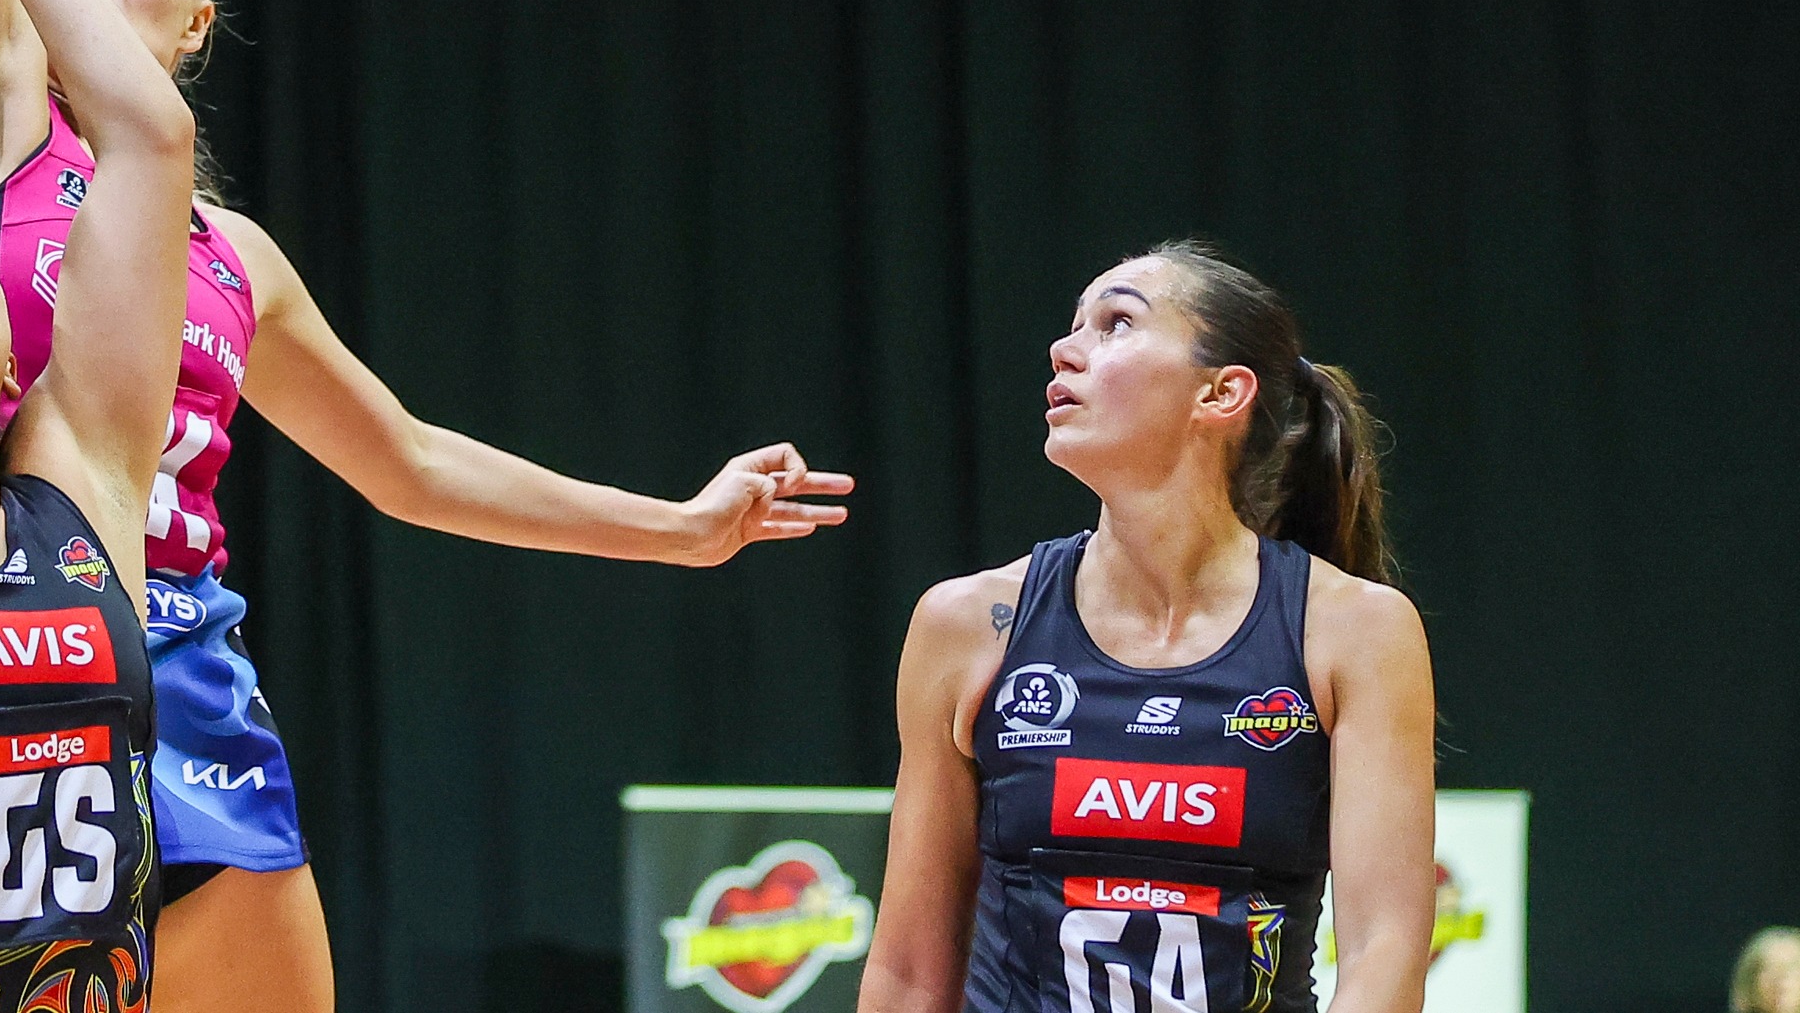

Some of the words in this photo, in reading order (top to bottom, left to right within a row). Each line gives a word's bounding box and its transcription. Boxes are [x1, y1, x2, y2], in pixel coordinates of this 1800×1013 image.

[182, 319, 215, 356] ark
[62, 561, 109, 578] magic
[1012, 701, 1052, 715] ANZ
[1226, 711, 1317, 731] magic
[1000, 731, 1068, 747] PREMIERSHIP
[1125, 724, 1181, 736] STRUDDYS
[11, 734, 85, 764] Lodge
[181, 760, 267, 791] KIA
[1074, 777, 1218, 826] AVIS
[1095, 879, 1186, 909] Lodge
[1059, 909, 1210, 1013] GA
